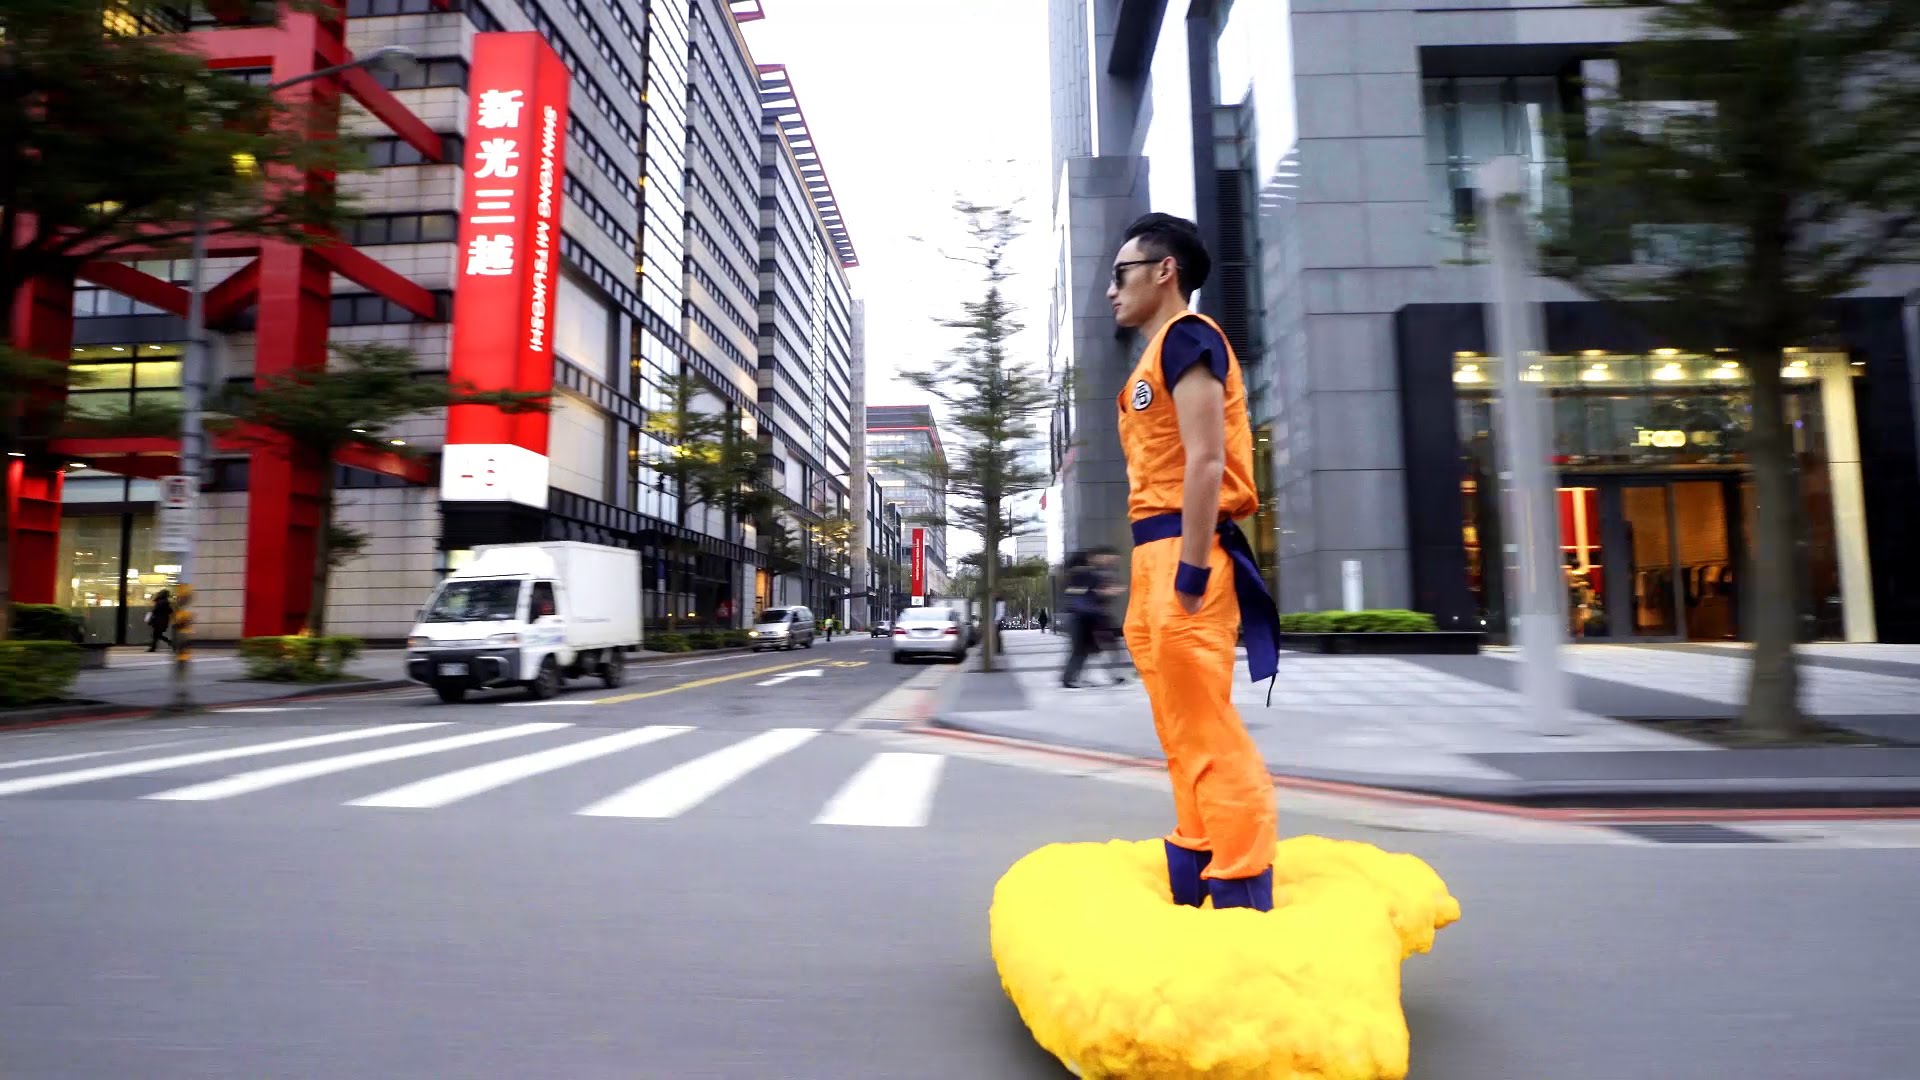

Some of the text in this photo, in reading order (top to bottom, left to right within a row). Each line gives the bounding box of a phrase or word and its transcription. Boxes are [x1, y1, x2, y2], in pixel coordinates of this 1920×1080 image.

[466, 89, 524, 276] 新光三越
[537, 157, 555, 218] KONG
